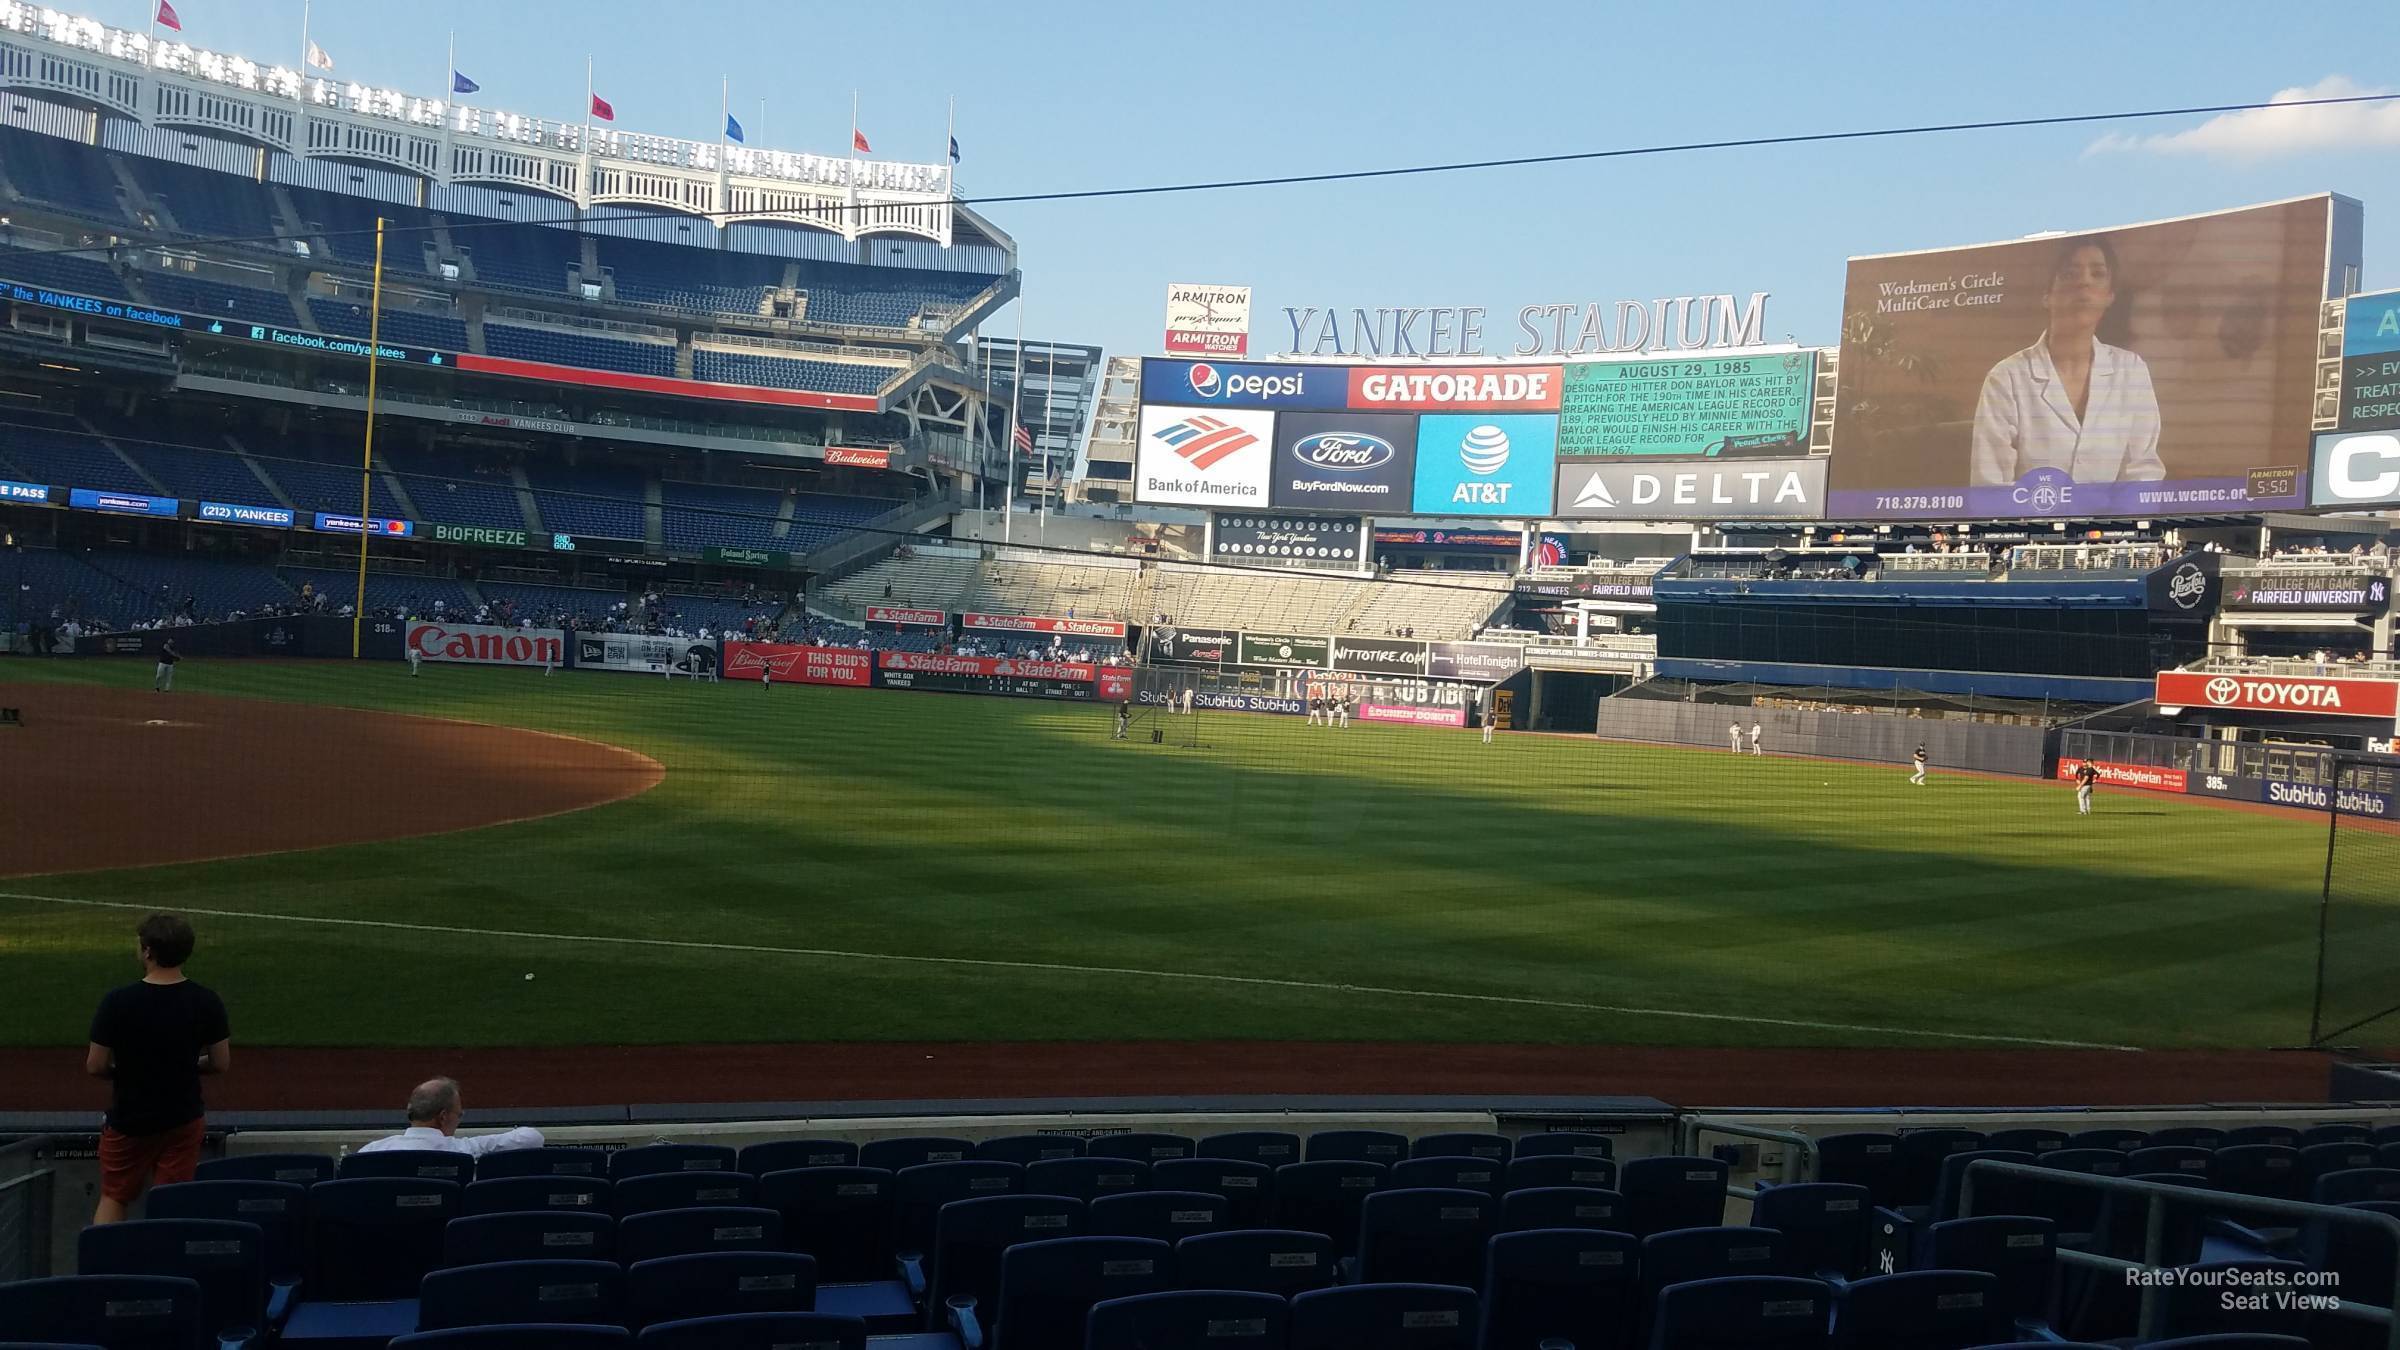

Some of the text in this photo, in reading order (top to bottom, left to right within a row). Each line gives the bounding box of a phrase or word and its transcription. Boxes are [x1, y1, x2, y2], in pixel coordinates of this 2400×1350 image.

[1879, 272, 2004, 297] Workmen's Circle
[1172, 291, 1246, 304] ARMITRON
[1877, 292, 2004, 313] MultiCare Center
[14, 287, 33, 300] the
[38, 291, 103, 313] YANKEES
[106, 304, 122, 317] on
[126, 306, 182, 327] facebook
[1282, 292, 1770, 357] YANKEE STADIUM
[1173, 333, 1240, 345] ARMITRON
[1204, 343, 1238, 351] WATCHES
[1619, 361, 1751, 379] AUGUST 29, 1985
[1226, 371, 1304, 400] pepsi
[1362, 372, 1550, 402] GATORADE
[1565, 375, 1801, 394] DESIGNATED HITTER DON BAYLOR WAS HIT BY
[1563, 394, 1571, 404] A
[1574, 394, 1603, 403] PITCH
[1606, 393, 1626, 403] FOR
[1630, 392, 1649, 402] THE
[1686, 390, 1711, 400] TIME
[1714, 389, 1725, 399] IN
[1729, 388, 1747, 398] HIS
[1750, 386, 1795, 398] CAREER,
[1563, 396, 1804, 414] BREAKING THE AMERICAN LEAGUE RECORD OF
[1587, 413, 1649, 424] PREVIOUSLY
[1652, 412, 1679, 422] HELD
[1682, 412, 1696, 422] BY
[1700, 410, 1739, 421] MINNIE
[1741, 408, 1786, 420] MINOSO.
[481, 416, 510, 426] Audi
[514, 419, 551, 431] YANKEES
[554, 422, 575, 433] CLUB
[1561, 419, 1798, 435] BAYLOR WOULD FINISH HIS CAREER WITH THE
[1560, 433, 1705, 445] MAJOR LEAGUE RECORD FOR
[826, 450, 887, 465] Budweiser
[1312, 436, 1374, 465] Ford
[1560, 446, 1580, 455] HBP
[1583, 446, 1609, 455] WITH
[2250, 469, 2295, 479] ARMITRON
[13, 487, 46, 498] PASS
[1148, 477, 1258, 497] Bank of America
[1292, 480, 1389, 494] BuyFordNow.com
[1453, 482, 1513, 505] AT&T
[1631, 471, 1807, 505] DELTA
[2257, 479, 2288, 494] 5:50
[1876, 495, 1964, 510] 718.379.8100
[2012, 484, 2073, 506] CARE
[203, 506, 289, 522] (212) YANKEES
[554, 534, 571, 543] AND
[1256, 531, 1271, 540] New
[1272, 532, 1289, 544] York
[721, 548, 769, 562] Poland Spring
[1543, 535, 1567, 559] HEATING
[1600, 575, 1633, 586] COLLEGE
[1634, 575, 1648, 586] HAT
[2261, 577, 2359, 591] COLLEGE HAT GAME
[1593, 585, 1630, 596] FAIRFIELD
[2252, 590, 2366, 604] FAIRFIELD UNIVERSITY
[2370, 581, 2385, 601] NY
[375, 623, 391, 633] 318
[408, 625, 561, 663] Canon
[1182, 633, 1233, 646] Panasonic
[807, 652, 869, 668] THIS BUD'S
[1334, 646, 1426, 666] NITTOTIRE.COM
[1457, 653, 1518, 669] HotelTonight
[807, 666, 857, 680] FOR YOU.
[887, 679, 911, 687] YANKEES
[1196, 694, 1245, 709] StubHub
[2243, 682, 2341, 708] TOYOTA
[1250, 697, 1300, 713] StubHub
[1417, 711, 1457, 723] DONUTS
[2206, 775, 2223, 790] 385
[2270, 782, 2327, 807] StubHub
[1880, 1248, 1894, 1276] NY
